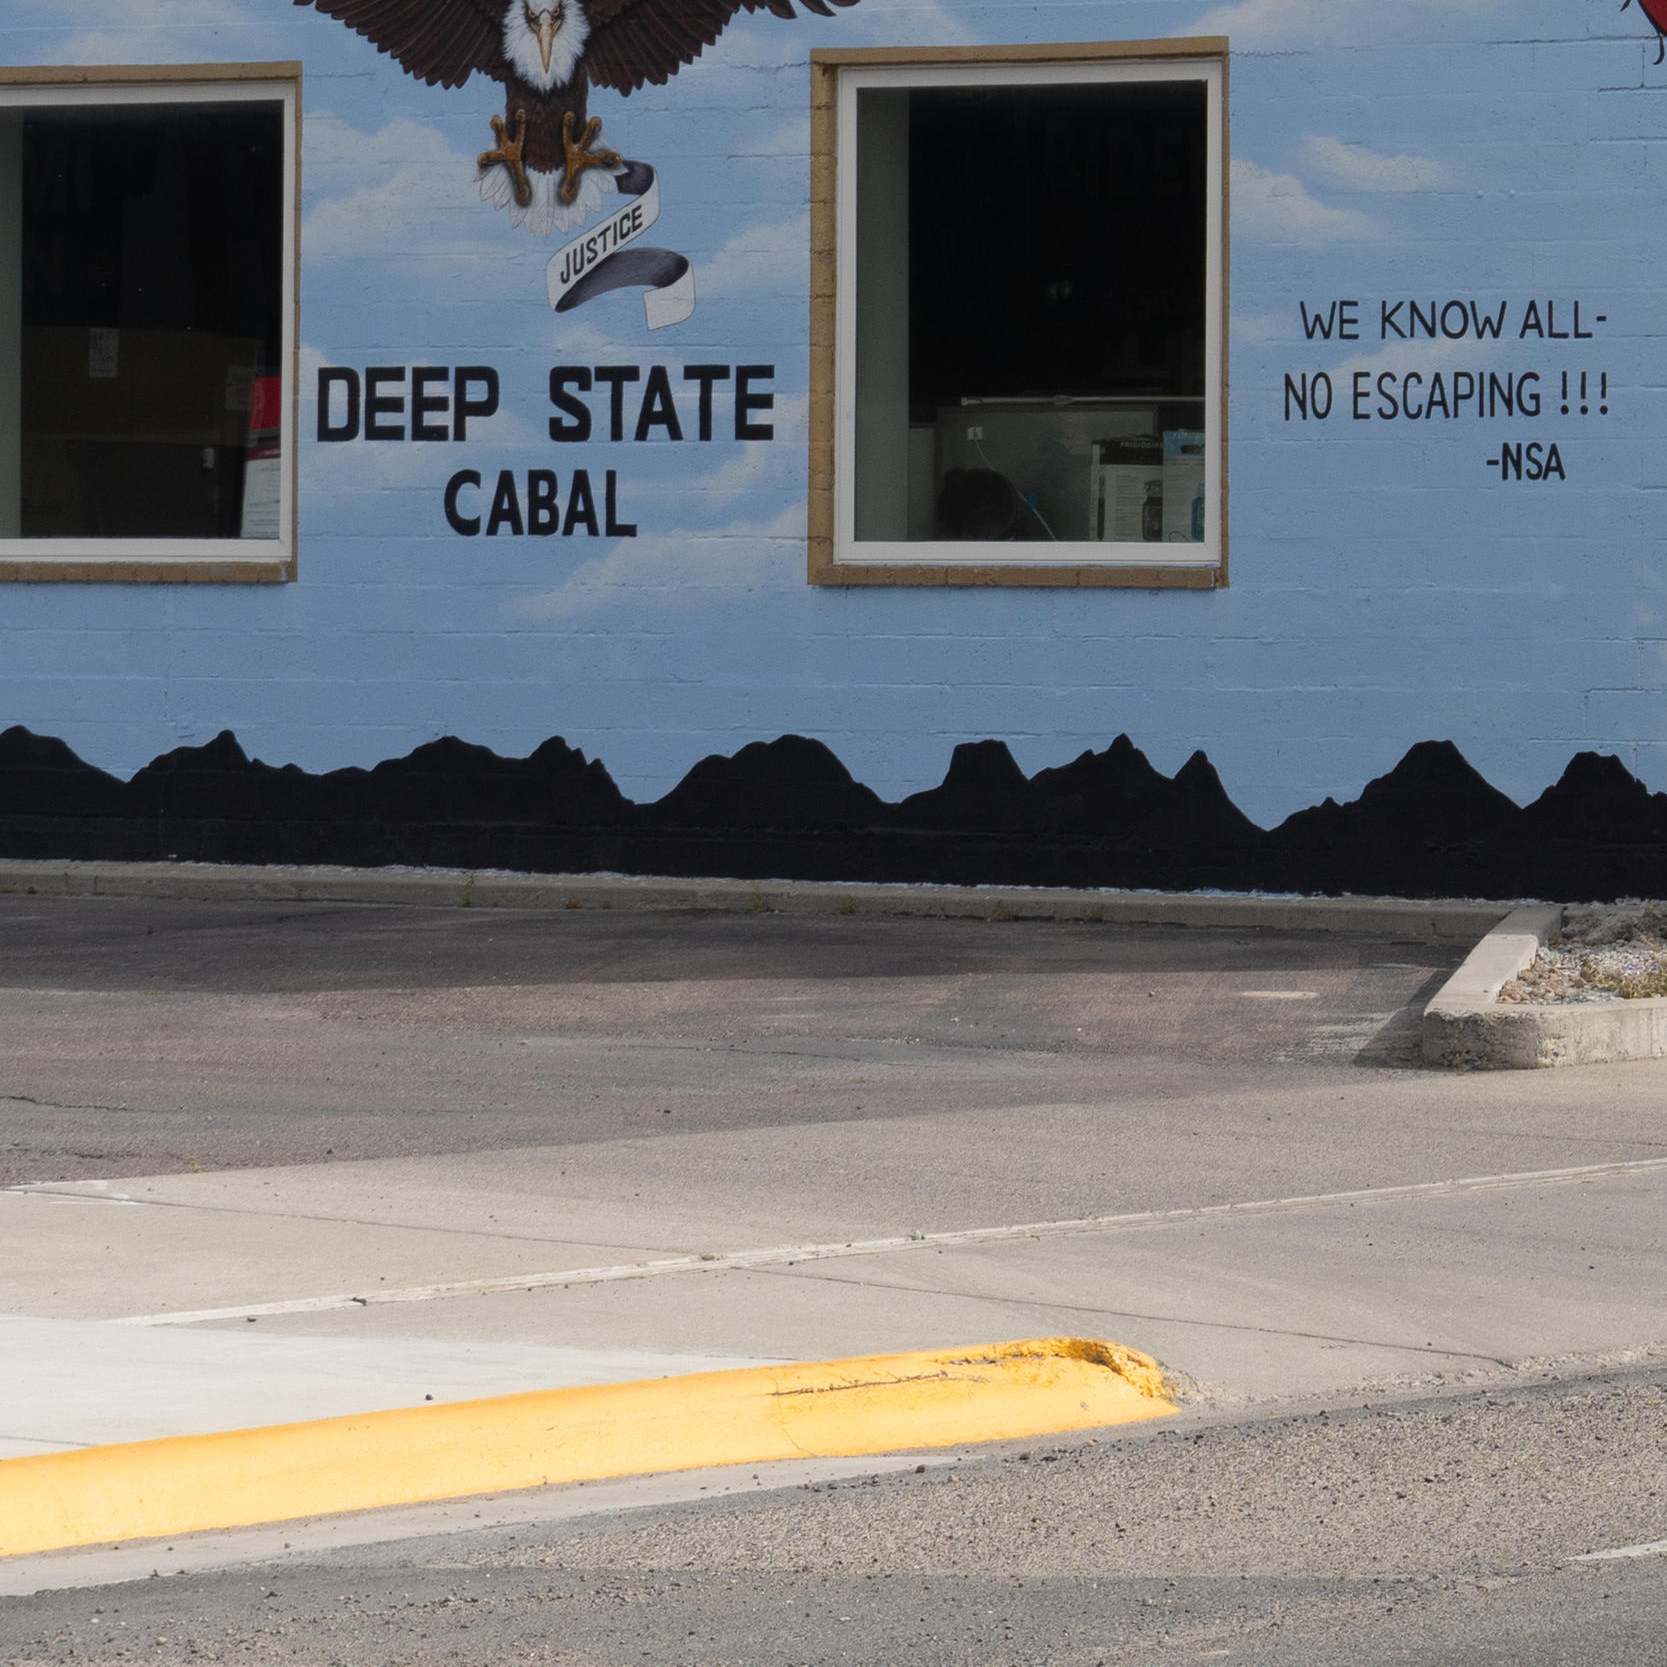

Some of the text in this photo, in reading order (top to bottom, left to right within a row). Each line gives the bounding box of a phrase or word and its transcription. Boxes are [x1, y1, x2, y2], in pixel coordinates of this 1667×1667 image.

[559, 204, 644, 285] JUSTICE
[1299, 300, 1360, 340] WE
[1381, 300, 1507, 340] KNOW
[317, 364, 775, 443] DEEP STATE
[1284, 371, 1333, 421] NO
[1352, 371, 1541, 420] ESCAPING
[443, 468, 638, 538] CABAL
